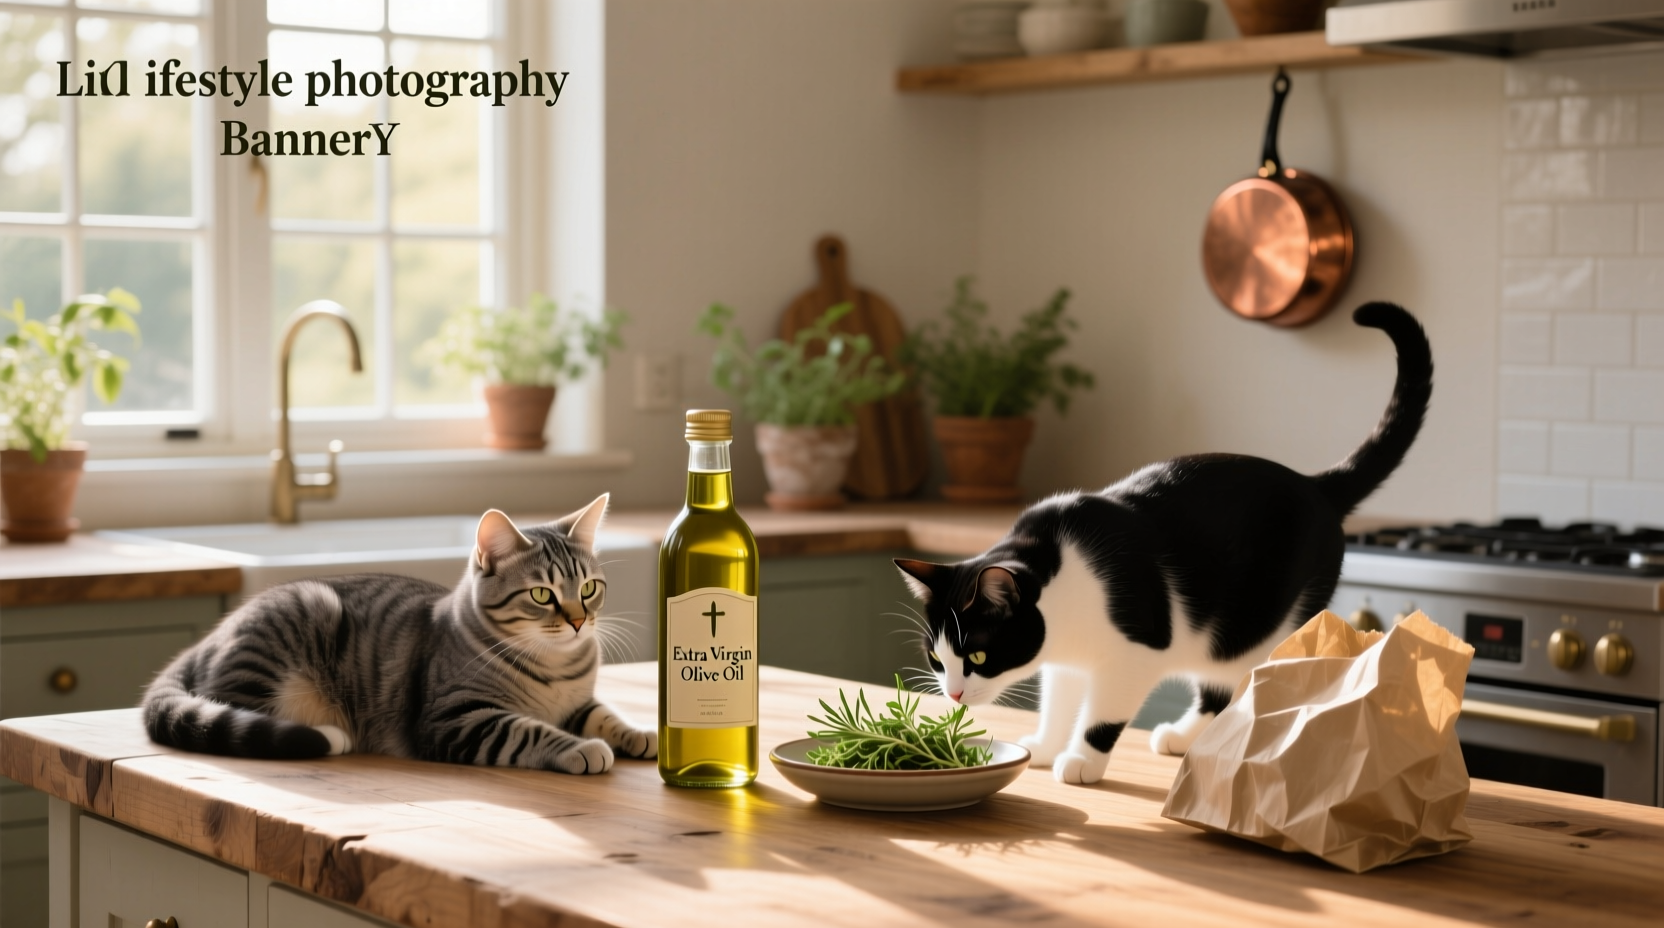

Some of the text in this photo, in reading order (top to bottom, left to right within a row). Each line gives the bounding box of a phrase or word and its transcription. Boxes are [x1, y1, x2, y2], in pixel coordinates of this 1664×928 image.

[673, 646, 752, 665] Extra Virgin
[681, 665, 744, 681] Olive Oil
